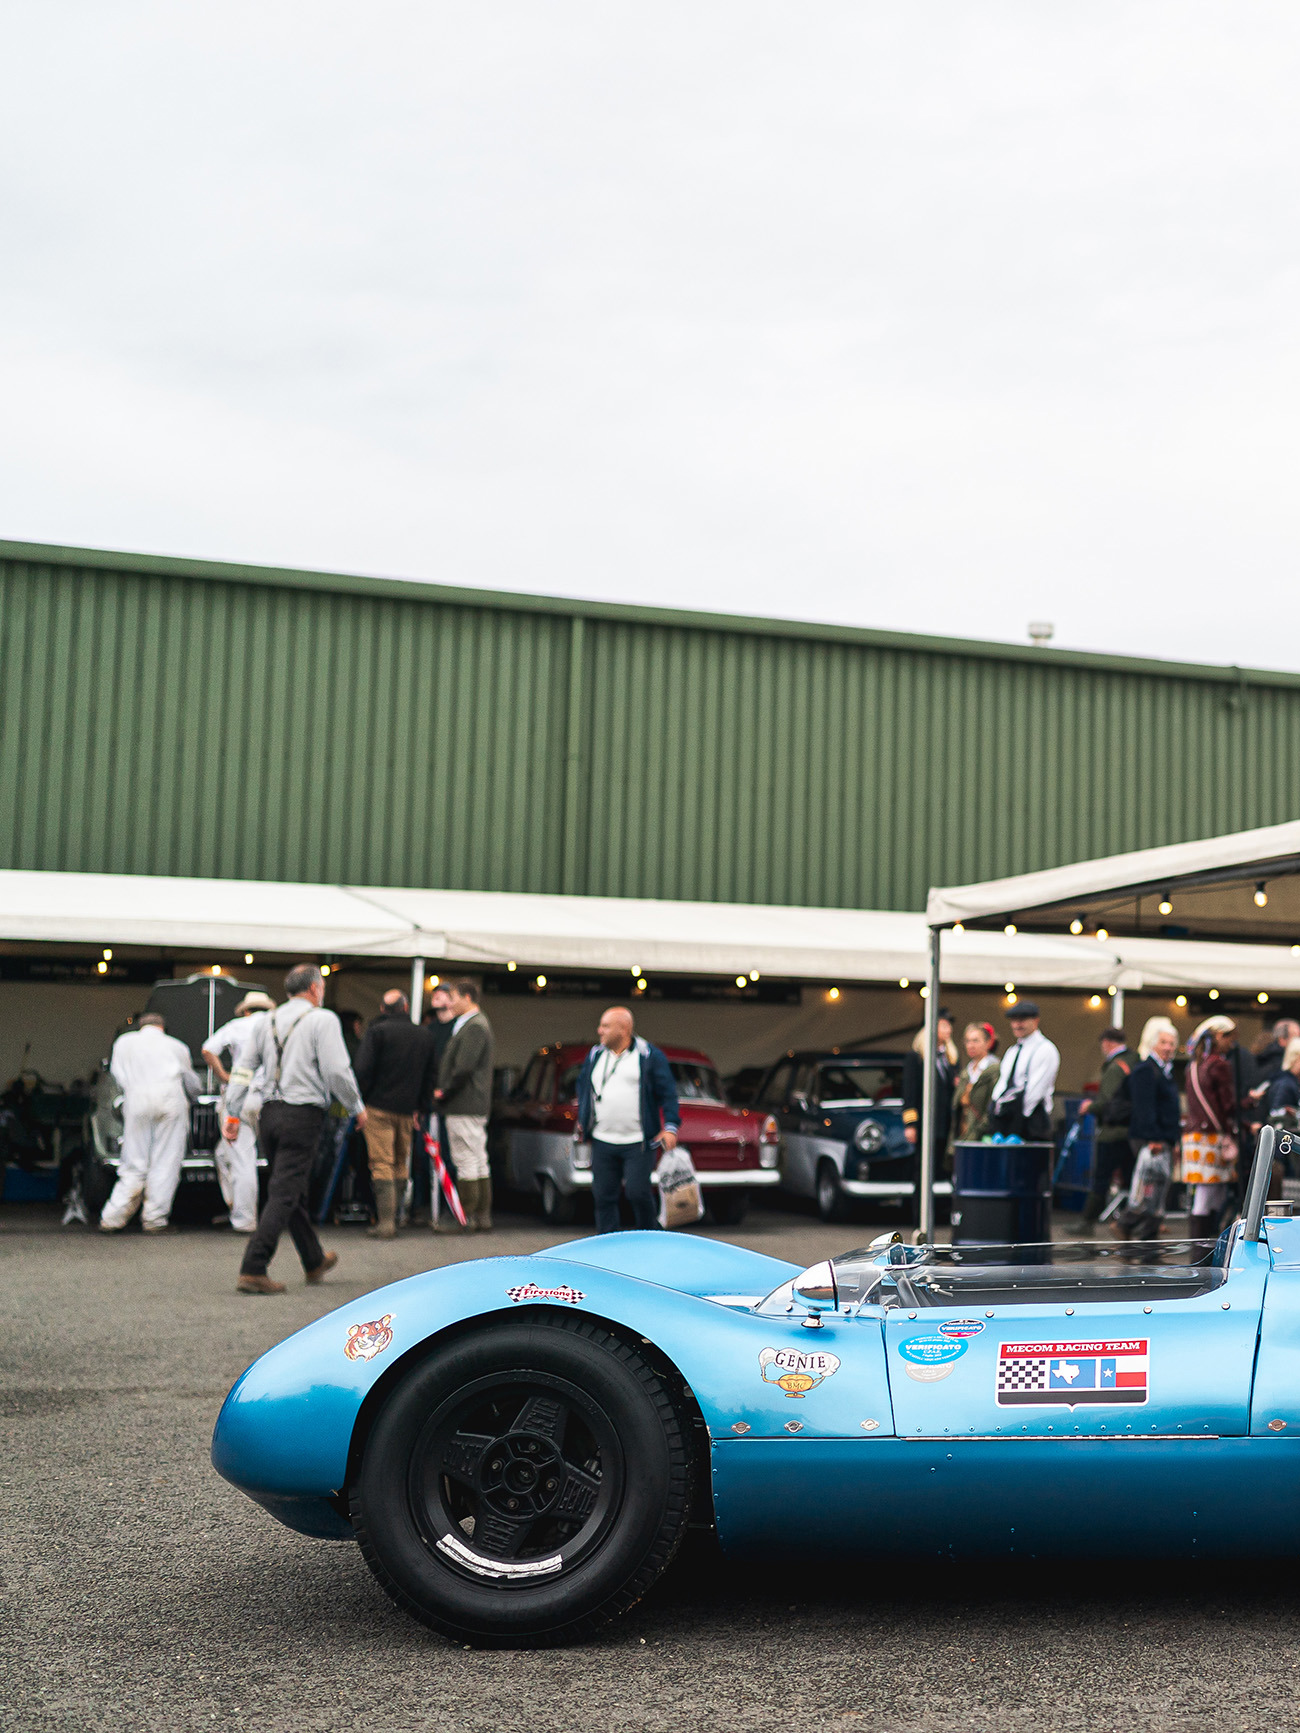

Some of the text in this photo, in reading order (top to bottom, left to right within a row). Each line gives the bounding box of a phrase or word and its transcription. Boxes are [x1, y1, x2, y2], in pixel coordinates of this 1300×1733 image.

[524, 1288, 571, 1297] Firestone
[1006, 1342, 1140, 1353] MECOM RACING TEAM
[775, 1352, 826, 1369] GENIE
[786, 1381, 805, 1390] BMC
